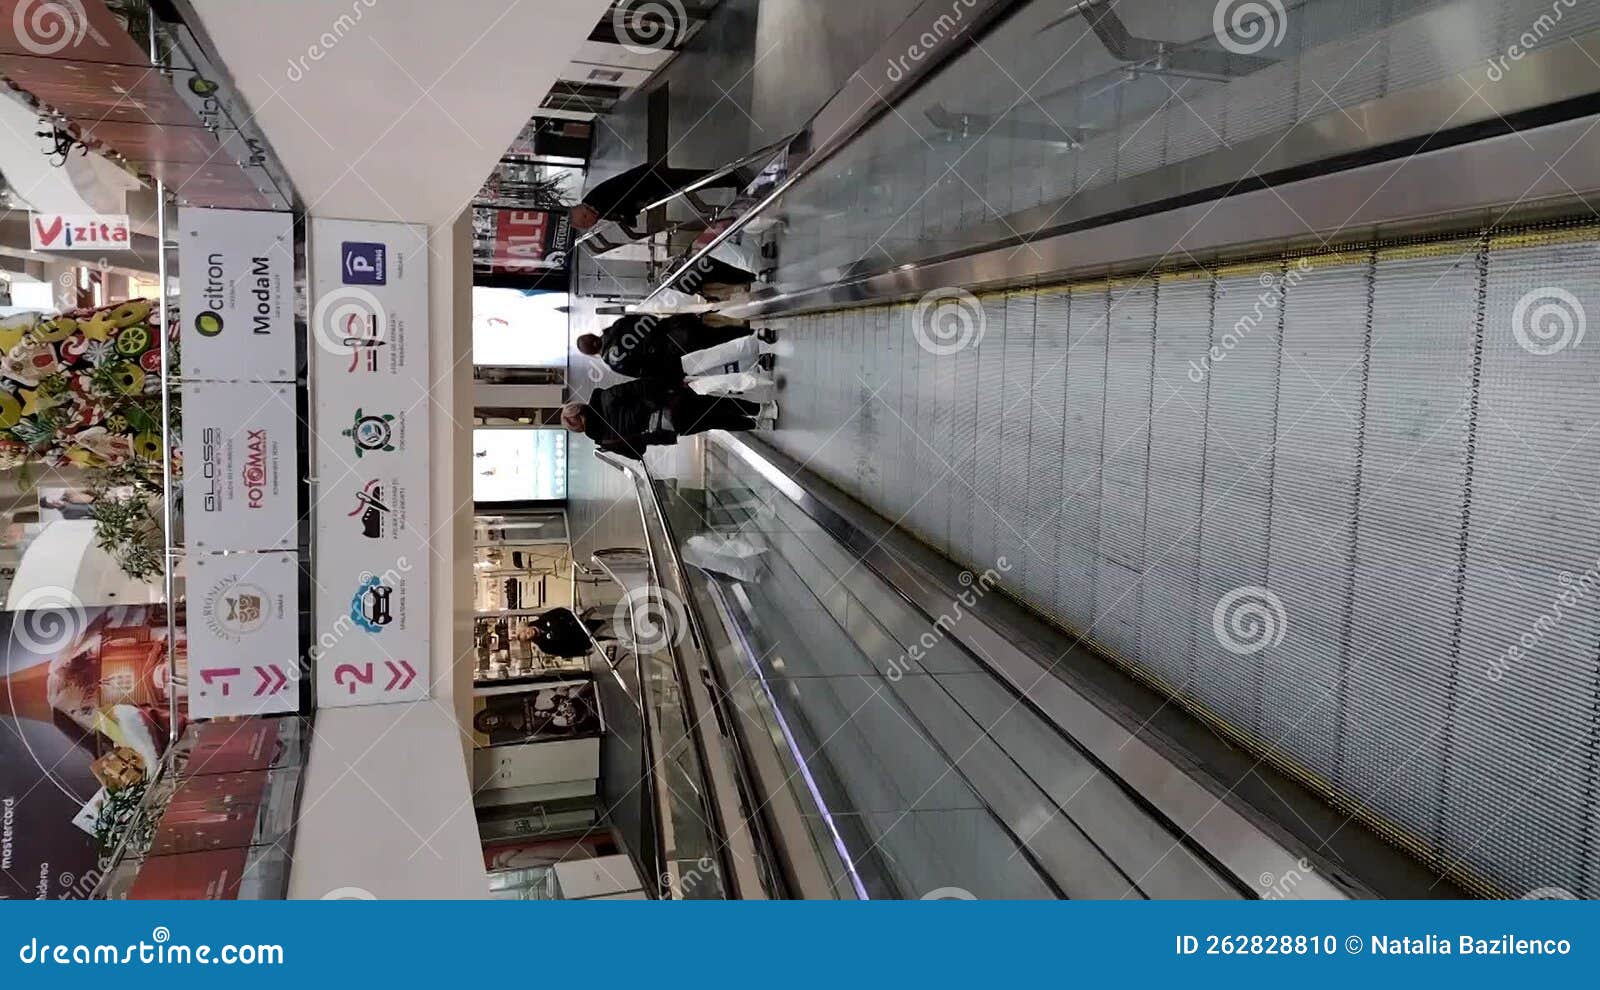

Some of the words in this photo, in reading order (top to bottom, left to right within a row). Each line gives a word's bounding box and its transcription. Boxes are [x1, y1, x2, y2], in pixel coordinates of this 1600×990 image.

[252, 257, 271, 335] ModaM
[203, 427, 215, 512] GLOSS
[247, 430, 265, 509] FOTOMAX
[200, 667, 241, 696] -1
[334, 662, 373, 694] -2
[2, 798, 15, 869] mastercard
